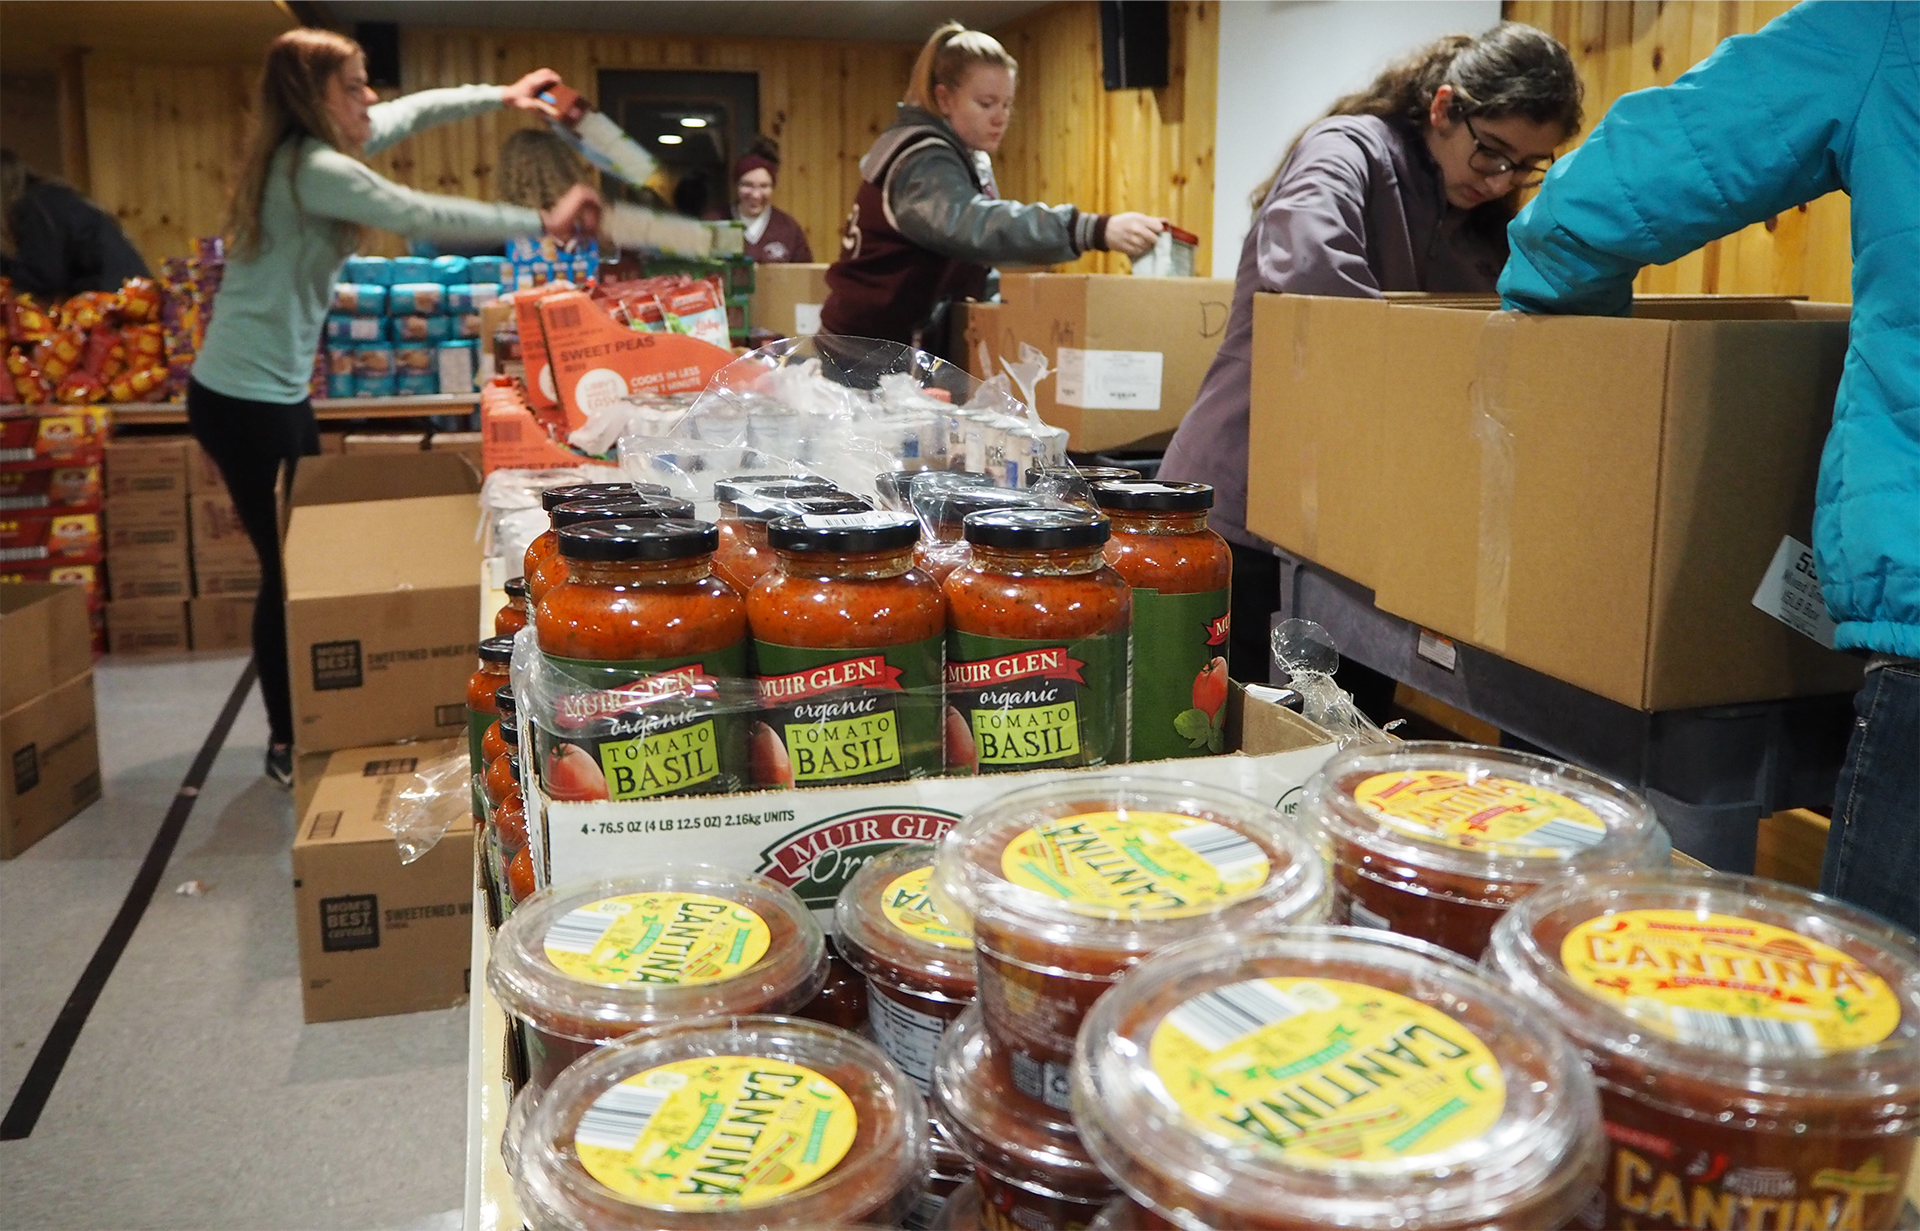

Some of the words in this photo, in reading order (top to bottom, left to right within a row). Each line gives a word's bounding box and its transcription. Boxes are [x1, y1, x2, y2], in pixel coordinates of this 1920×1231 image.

[560, 343, 610, 362] SWEET
[615, 335, 656, 353] PEAS
[630, 372, 664, 387] COOKS
[665, 370, 677, 381] IN
[678, 365, 700, 378] LESS
[758, 674, 806, 698] MUIR
[810, 659, 877, 689] GLEN
[948, 663, 991, 684] MUIR
[994, 651, 1059, 678] GLEN
[563, 691, 623, 718] MUIR
[627, 668, 696, 700] GLEN
[794, 690, 877, 735] organic
[979, 681, 1058, 723] organic
[610, 707, 697, 750] organic
[792, 717, 890, 744] TOMATO
[977, 707, 1070, 730] TOMATO
[608, 727, 710, 763] TOMATO
[795, 736, 893, 776] BASIL
[979, 726, 1073, 760] BASIL
[612, 747, 714, 796] BASIL
[599, 821, 624, 834] 76.5
[627, 820, 642, 832] OZ
[659, 819, 674, 831] LB
[677, 817, 701, 830] 12.5
[703, 815, 721, 828] OZ)
[724, 813, 761, 827] 2.16kg
[764, 810, 795, 823] UNITS
[789, 819, 881, 865] MUIR
[891, 815, 953, 841] GLE
[326, 912, 373, 929] BEST
[385, 904, 456, 922] SWEETENED
[627, 901, 728, 984] CANTINA
[1585, 934, 1877, 997] CANTINA
[1219, 1024, 1470, 1148] CANTINA
[677, 1070, 804, 1196] CANTINA
